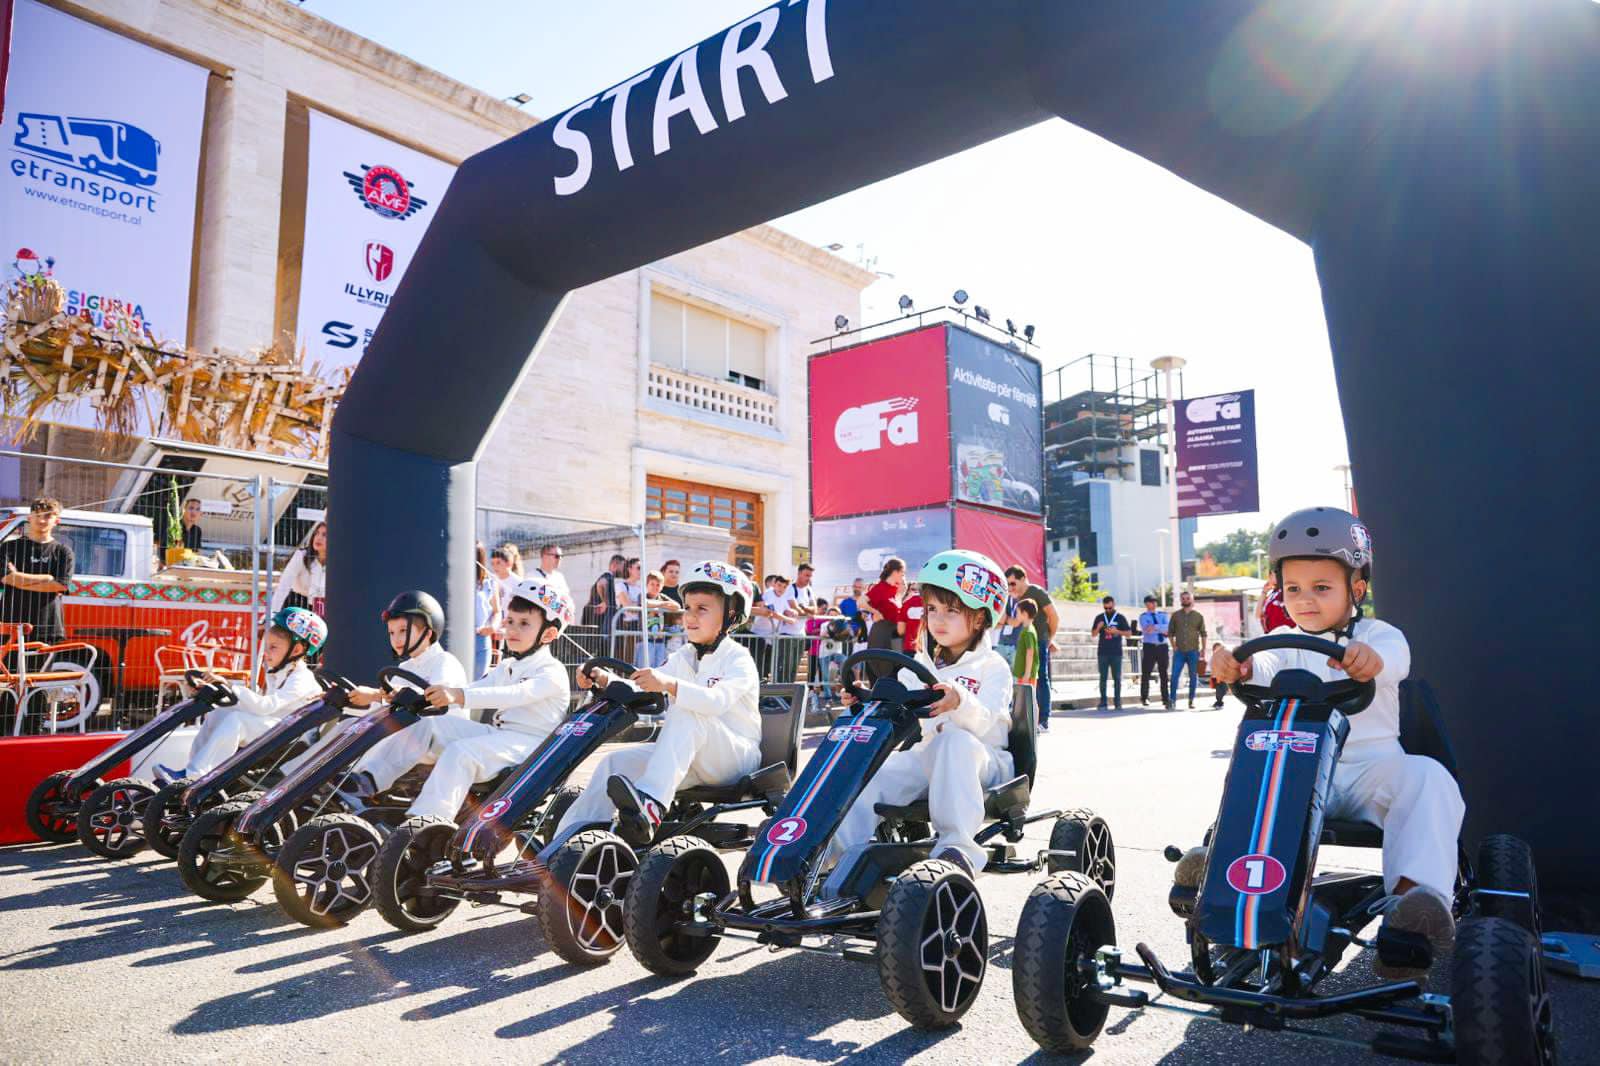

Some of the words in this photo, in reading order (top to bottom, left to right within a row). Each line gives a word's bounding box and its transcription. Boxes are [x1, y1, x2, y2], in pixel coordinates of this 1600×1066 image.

[552, 0, 835, 196] START
[10, 158, 157, 214] etransport
[24, 186, 142, 226] www.etransport.al
[344, 283, 389, 305] ILLYRI
[953, 366, 997, 393] Aktivitete
[482, 800, 506, 818] 3
[775, 820, 799, 842] 2
[1245, 860, 1265, 888] 1
